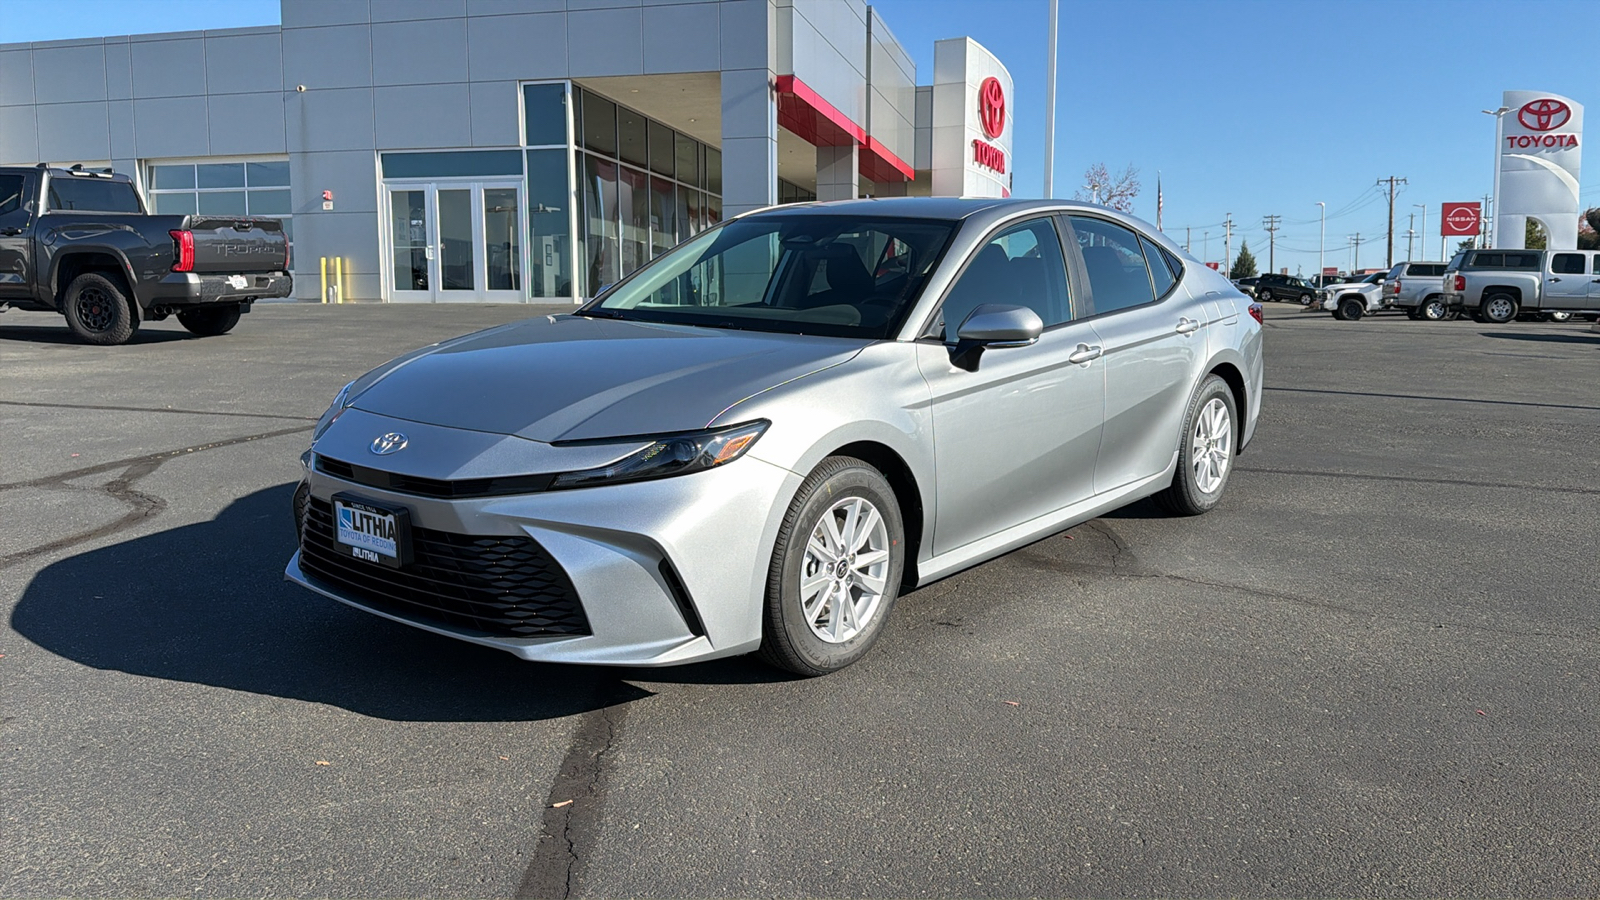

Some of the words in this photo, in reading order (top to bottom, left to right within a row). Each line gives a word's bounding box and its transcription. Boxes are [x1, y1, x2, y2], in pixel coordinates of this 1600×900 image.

[1506, 134, 1579, 149] TOYOTA
[972, 139, 1005, 174] TOYOTA
[352, 510, 396, 542] LITHIA
[340, 529, 362, 541] TOYOTA
[362, 535, 371, 543] OF
[358, 547, 380, 563] LITHIA
